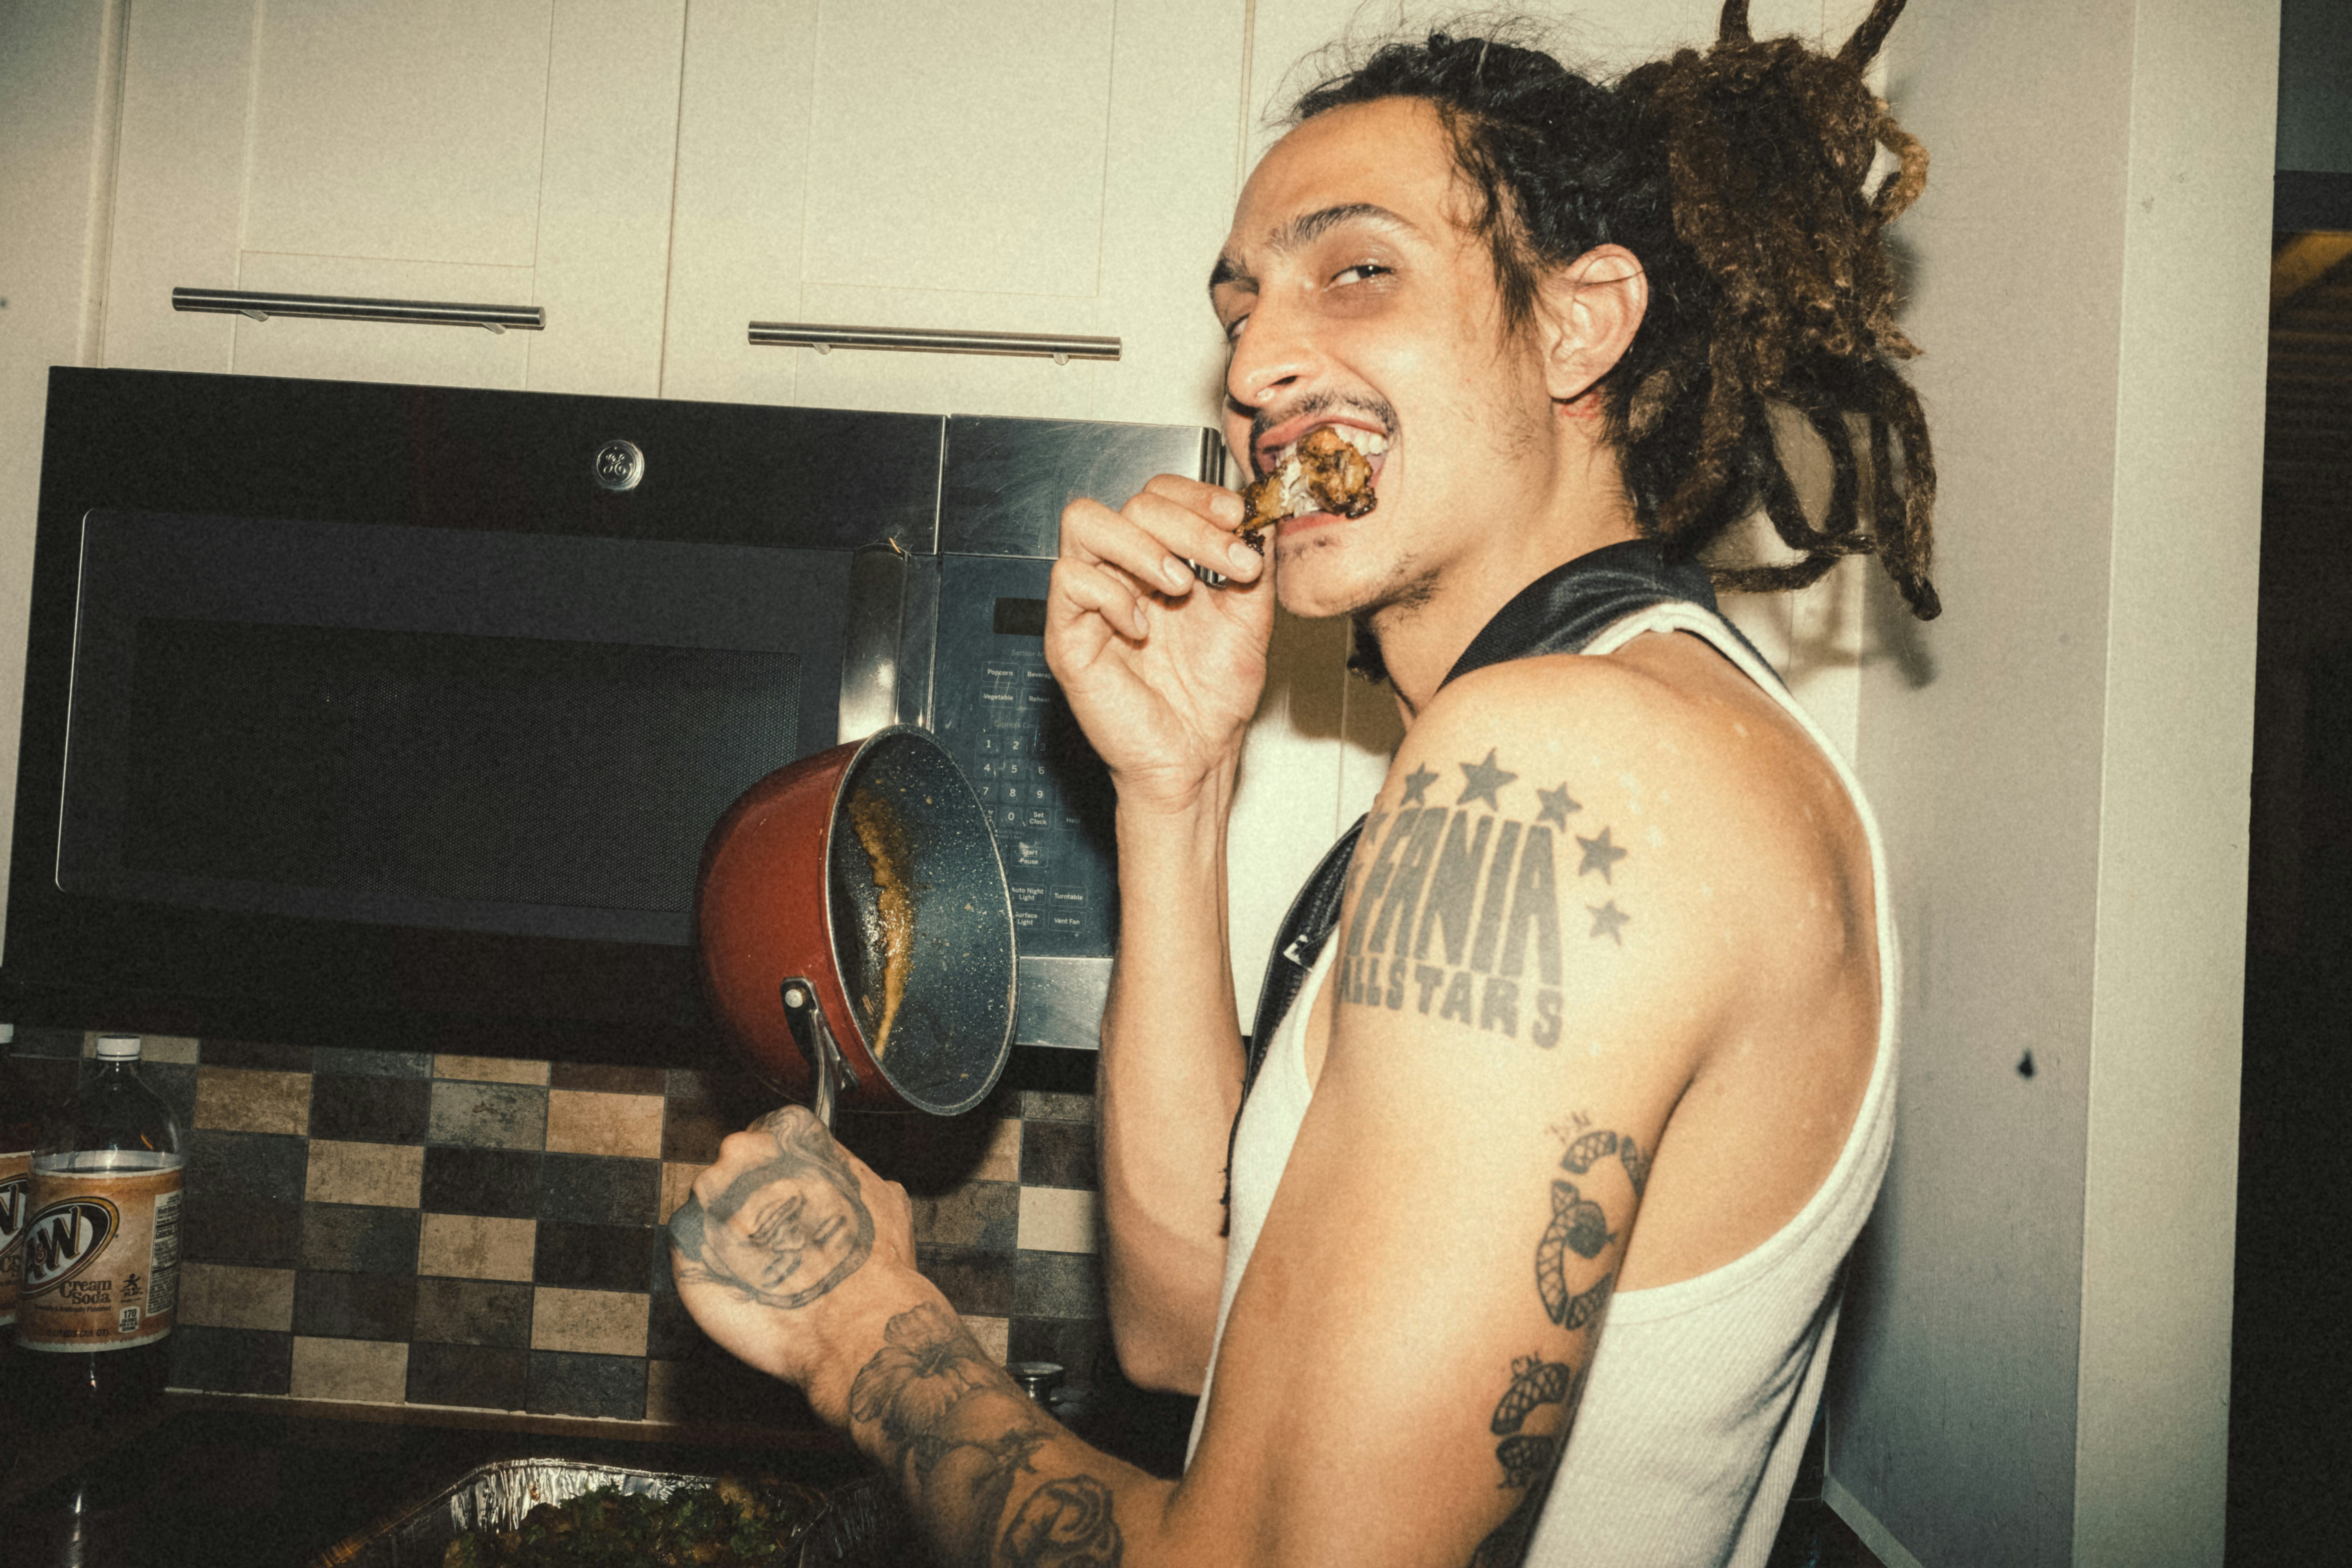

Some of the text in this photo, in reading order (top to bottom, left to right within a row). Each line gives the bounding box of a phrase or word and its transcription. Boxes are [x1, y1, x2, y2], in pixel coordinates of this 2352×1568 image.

[1013, 741, 1019, 749] 2
[1011, 765, 1017, 773] 5
[1010, 788, 1016, 797] 8
[1008, 812, 1015, 821] 0
[1345, 806, 1564, 987] FANIA
[26, 1205, 82, 1280] A&W
[59, 1280, 112, 1298] Cream
[72, 1291, 111, 1305] Soda
[59, 1305, 86, 1313] Artificially
[124, 1309, 137, 1318] 170
[53, 1329, 78, 1337] LITERS
